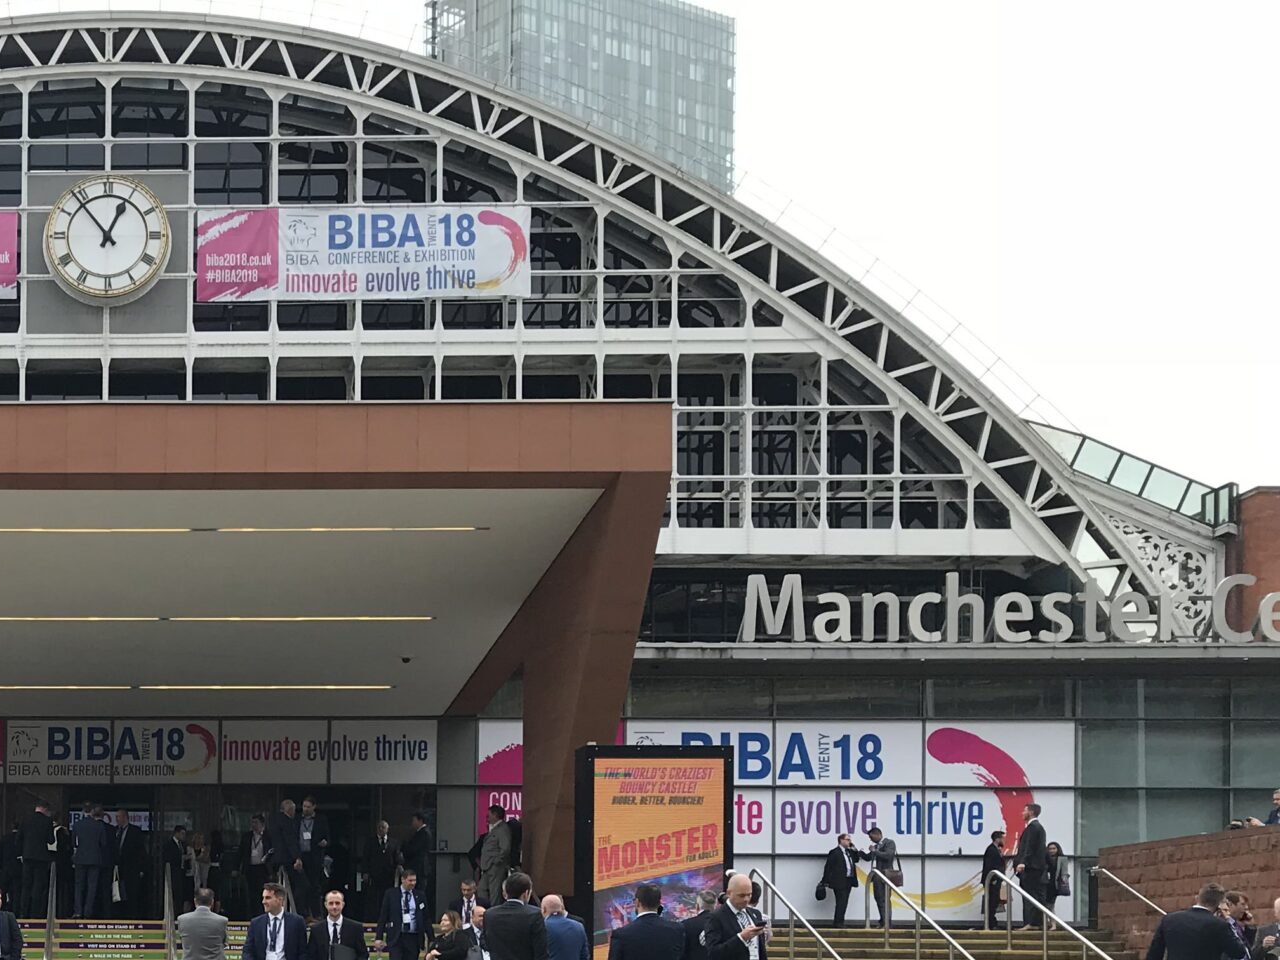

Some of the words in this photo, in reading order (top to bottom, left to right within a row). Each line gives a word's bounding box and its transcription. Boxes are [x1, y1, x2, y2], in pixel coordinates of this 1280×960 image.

[328, 214, 426, 250] BIBA
[428, 214, 437, 248] TWENTY
[438, 213, 476, 248] 18
[206, 252, 272, 267] biba2018.co.uk
[285, 253, 320, 266] BIBA
[328, 251, 401, 265] CONFERENCE
[403, 251, 411, 264] &
[414, 249, 476, 263] EXHIBITION
[206, 269, 258, 283] #BIBA2018
[285, 269, 358, 293] innovate
[366, 267, 420, 292] evolve
[425, 265, 476, 290] thrive
[742, 572, 1174, 643] Manchester
[47, 727, 140, 760] BIBA
[141, 727, 152, 761] TWENTY
[152, 728, 185, 761] 18
[223, 734, 300, 762] innovate
[306, 734, 368, 762] evolve
[374, 734, 428, 762] thrive
[818, 733, 830, 780] TWENTY
[834, 734, 883, 780] 18
[8, 764, 41, 776] BIBA
[47, 764, 110, 776] CONFERENCE
[122, 764, 176, 776] EXHIBITION
[604, 768, 623, 780] THE
[624, 768, 667, 780] WORLD'S
[669, 768, 714, 780] CRAZIEST
[619, 782, 656, 794] BOUNCY
[658, 782, 698, 794] CASTLE!
[780, 792, 877, 836] evolve
[893, 792, 984, 836] thrive
[598, 834, 612, 846] THE
[598, 823, 718, 874] MONSTER
